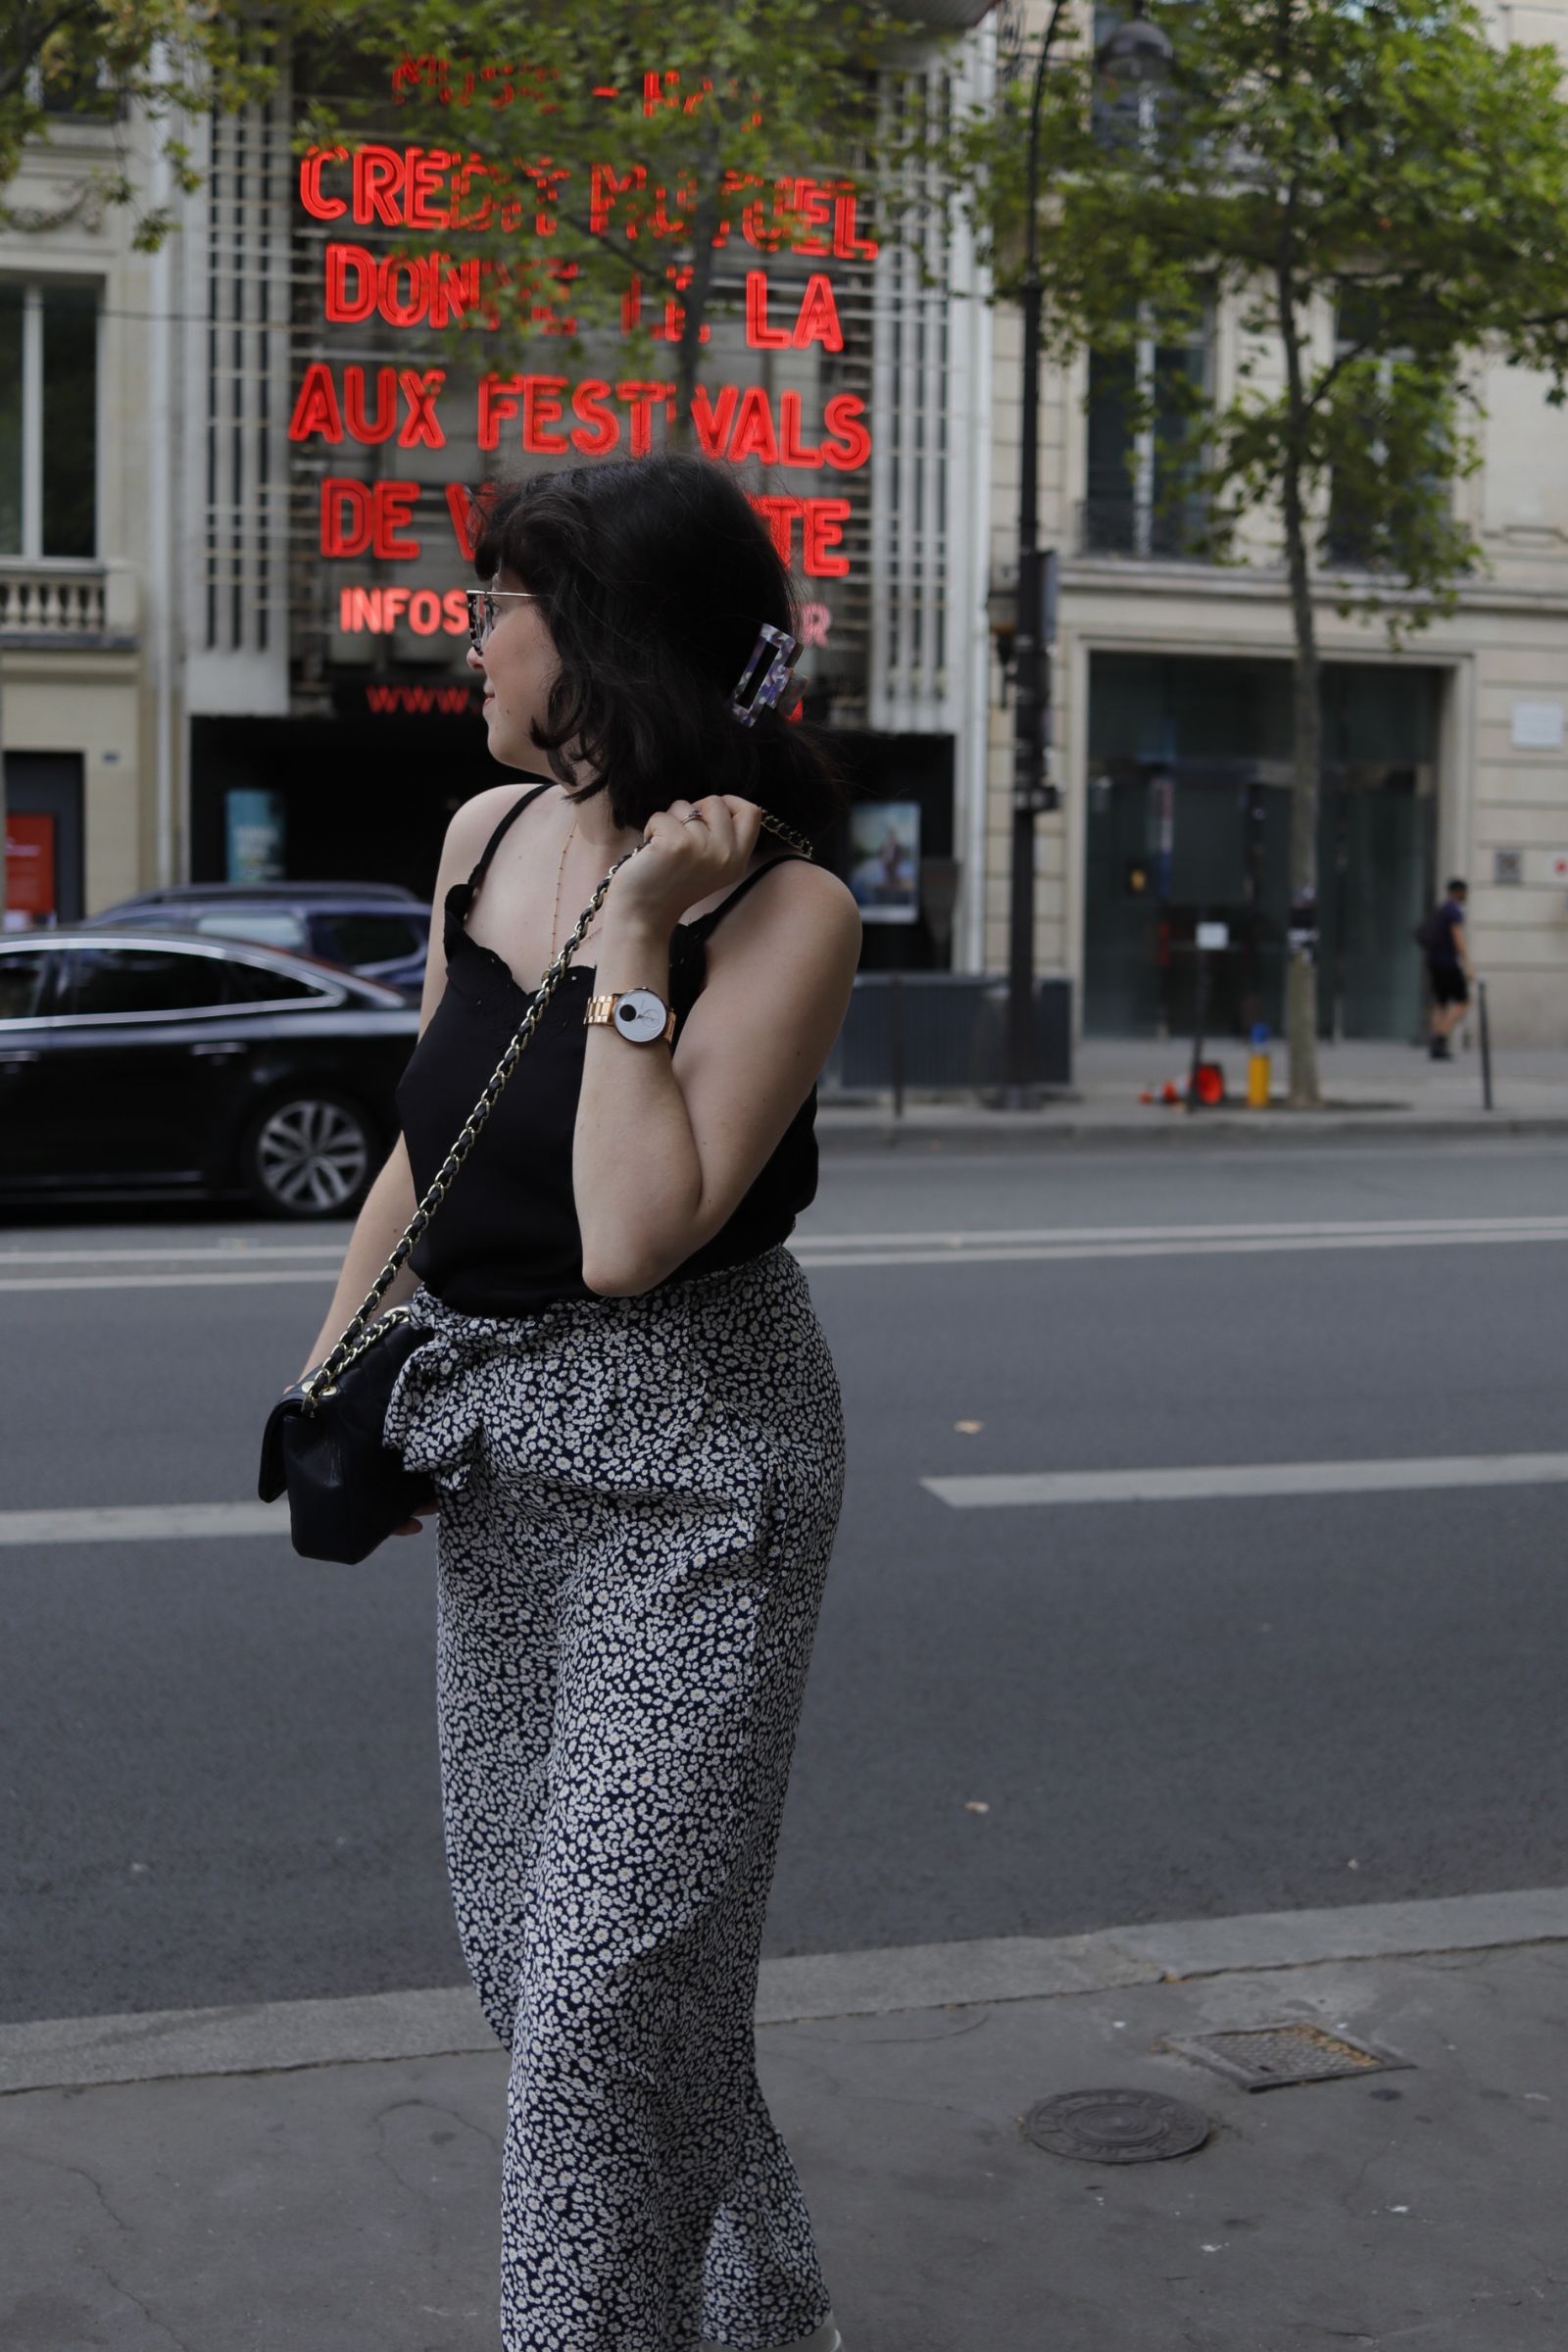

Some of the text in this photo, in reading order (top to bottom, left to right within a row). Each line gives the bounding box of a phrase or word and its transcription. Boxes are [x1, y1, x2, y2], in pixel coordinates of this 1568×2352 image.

[747, 270, 844, 352] LA
[289, 364, 446, 448] AUX
[320, 478, 420, 560] DE
[340, 586, 469, 636] INFOS
